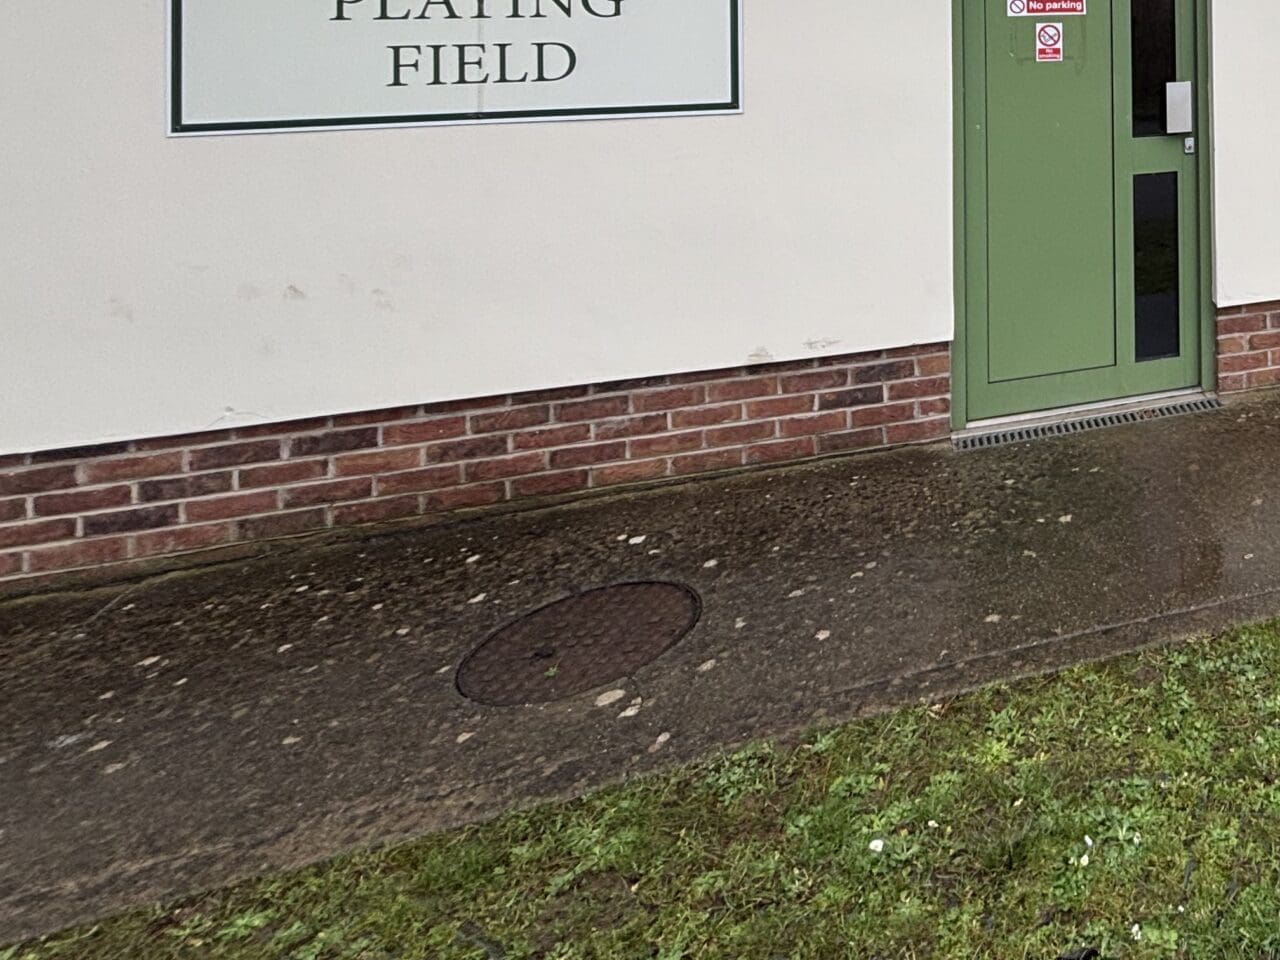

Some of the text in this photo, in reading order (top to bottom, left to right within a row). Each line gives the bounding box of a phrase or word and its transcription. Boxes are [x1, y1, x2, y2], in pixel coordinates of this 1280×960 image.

[1029, 0, 1082, 11] No parking
[386, 41, 577, 87] FIELD
